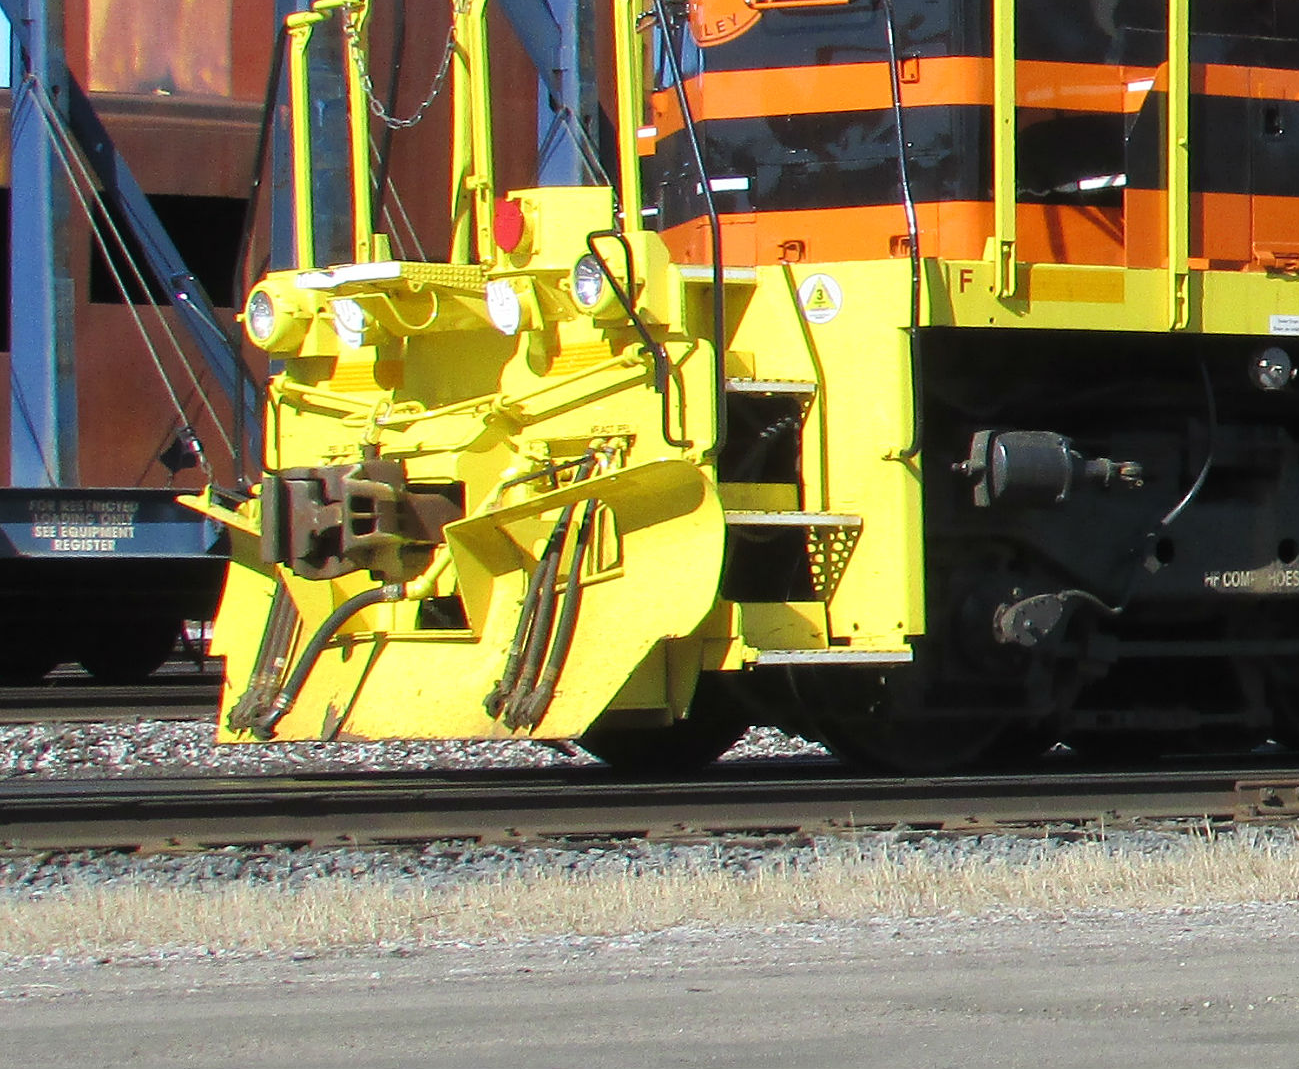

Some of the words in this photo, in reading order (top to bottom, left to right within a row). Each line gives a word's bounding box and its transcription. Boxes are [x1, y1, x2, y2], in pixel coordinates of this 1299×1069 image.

[959, 268, 974, 294] F
[816, 288, 824, 301] 3
[33, 526, 56, 538] SEE
[60, 526, 135, 538] EQUIPMENT
[53, 538, 116, 551] REGISTER
